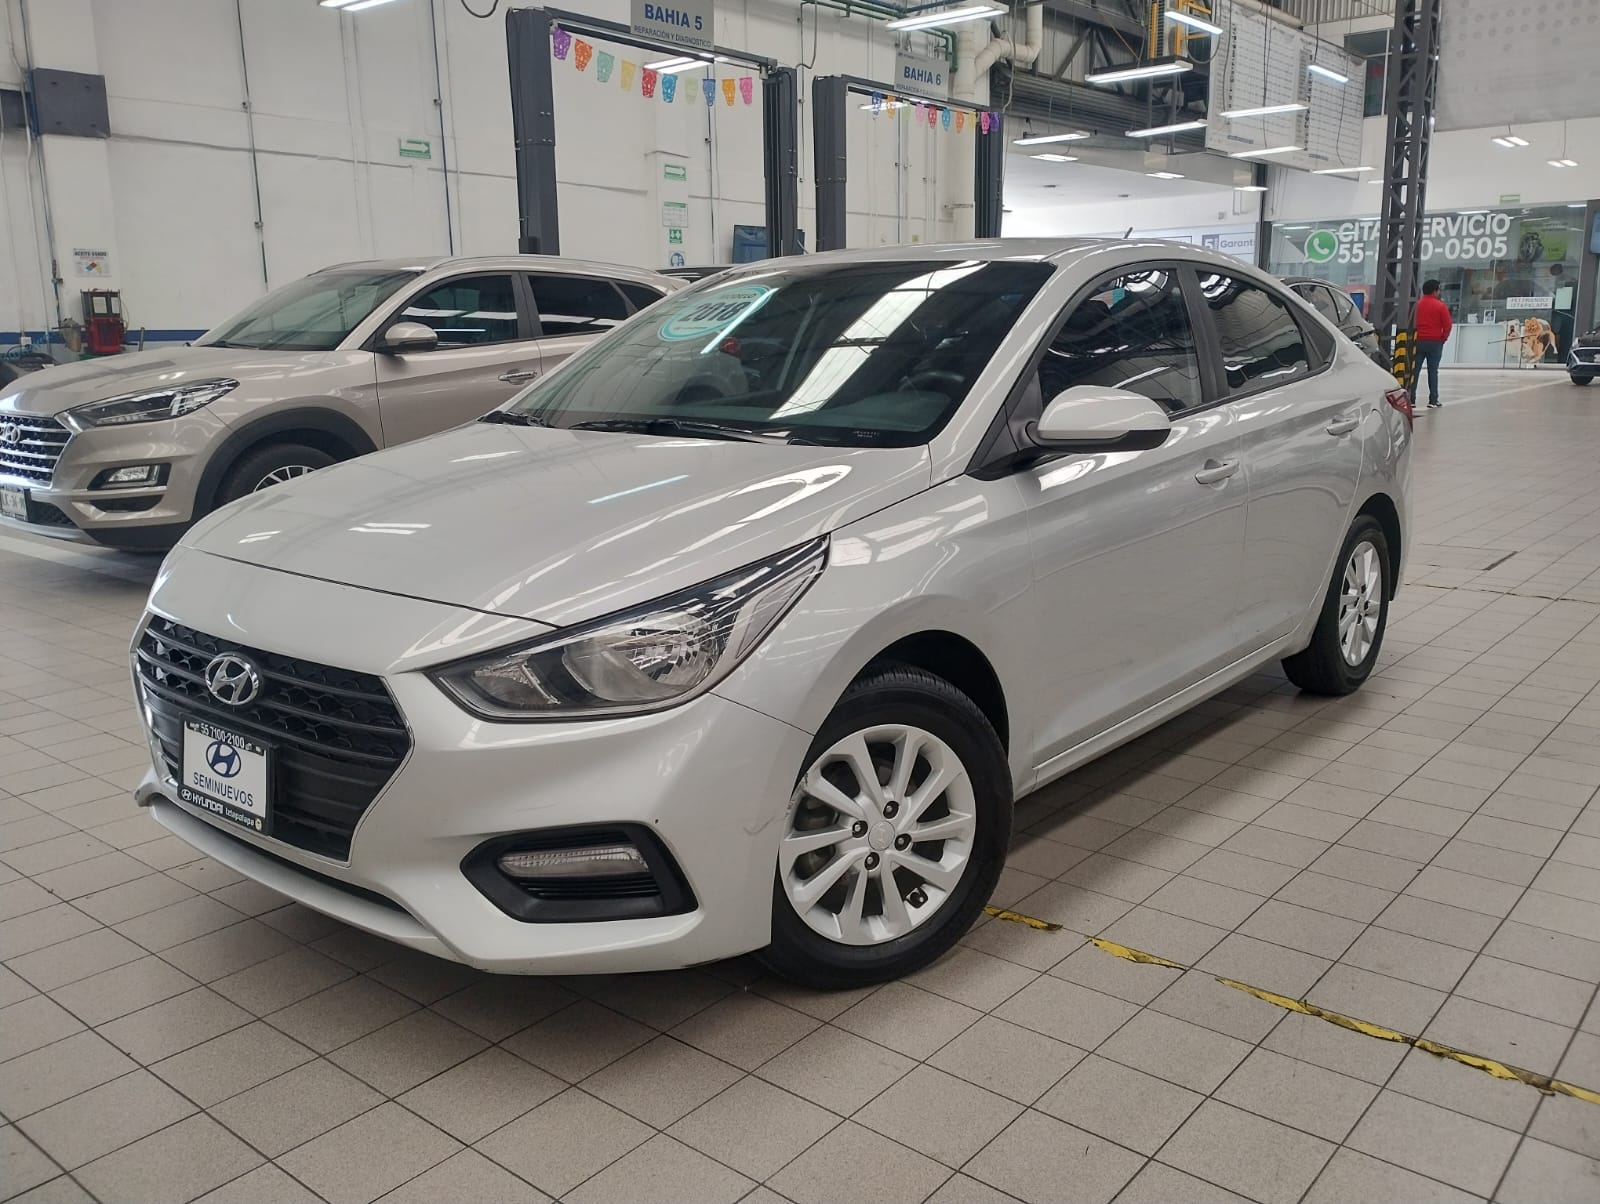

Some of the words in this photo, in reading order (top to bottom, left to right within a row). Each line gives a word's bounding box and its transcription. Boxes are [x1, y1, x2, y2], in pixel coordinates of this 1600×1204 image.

[644, 3, 690, 28] BAHIA
[694, 15, 703, 31] 5
[903, 65, 934, 85] BAHIA
[935, 73, 942, 86] 6
[1422, 213, 1510, 238] ERVICIO
[200, 723, 209, 736] 55
[193, 771, 254, 807] SEMINUEVOS
[192, 792, 224, 815] HYUNDAI
